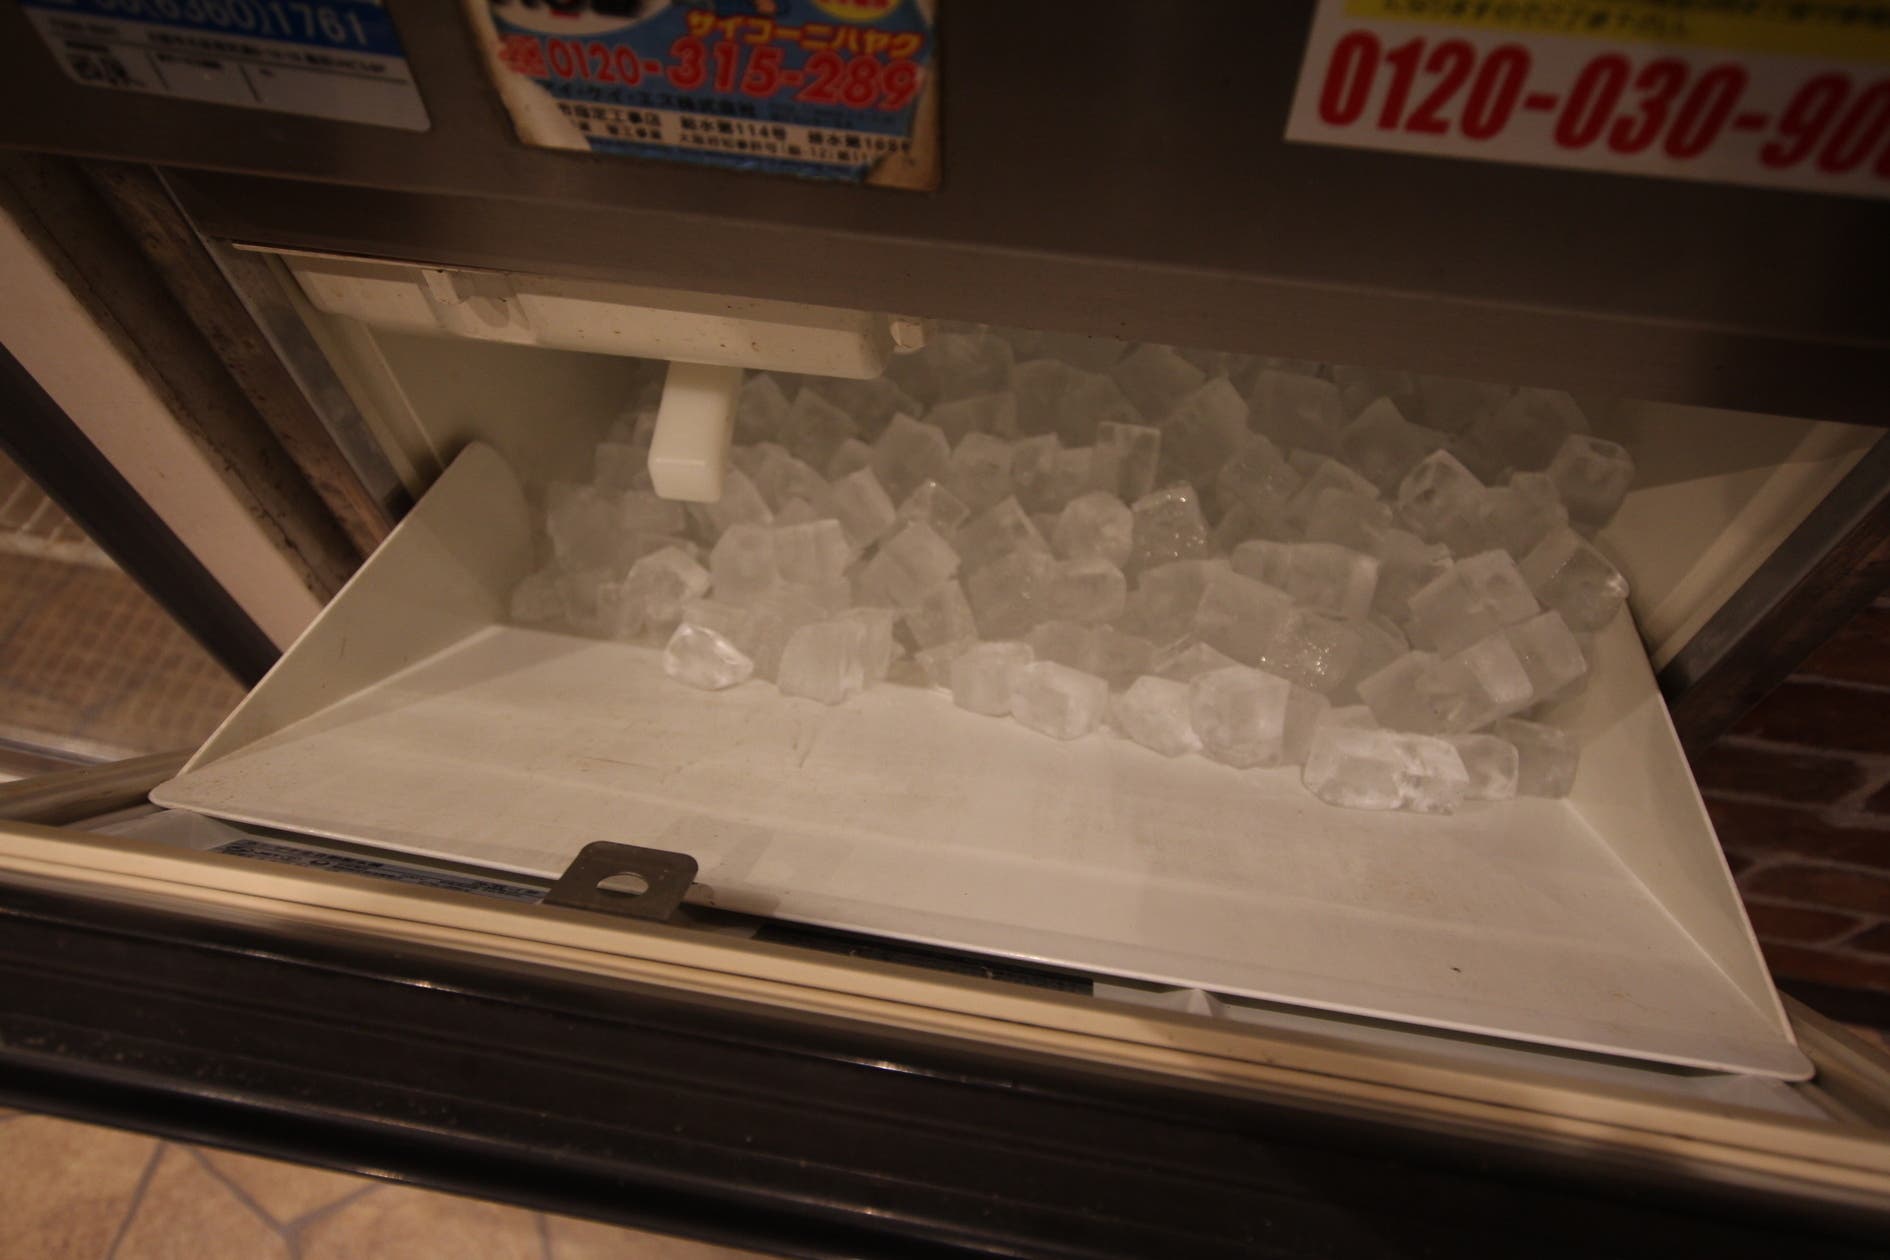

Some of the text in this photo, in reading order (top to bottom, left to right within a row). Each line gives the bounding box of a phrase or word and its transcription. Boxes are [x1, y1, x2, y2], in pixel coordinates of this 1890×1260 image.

[686, 10, 925, 58] サイコーニハヤク
[549, 36, 921, 111] 0120-315-289
[1317, 29, 1890, 180] 0120-030-90
